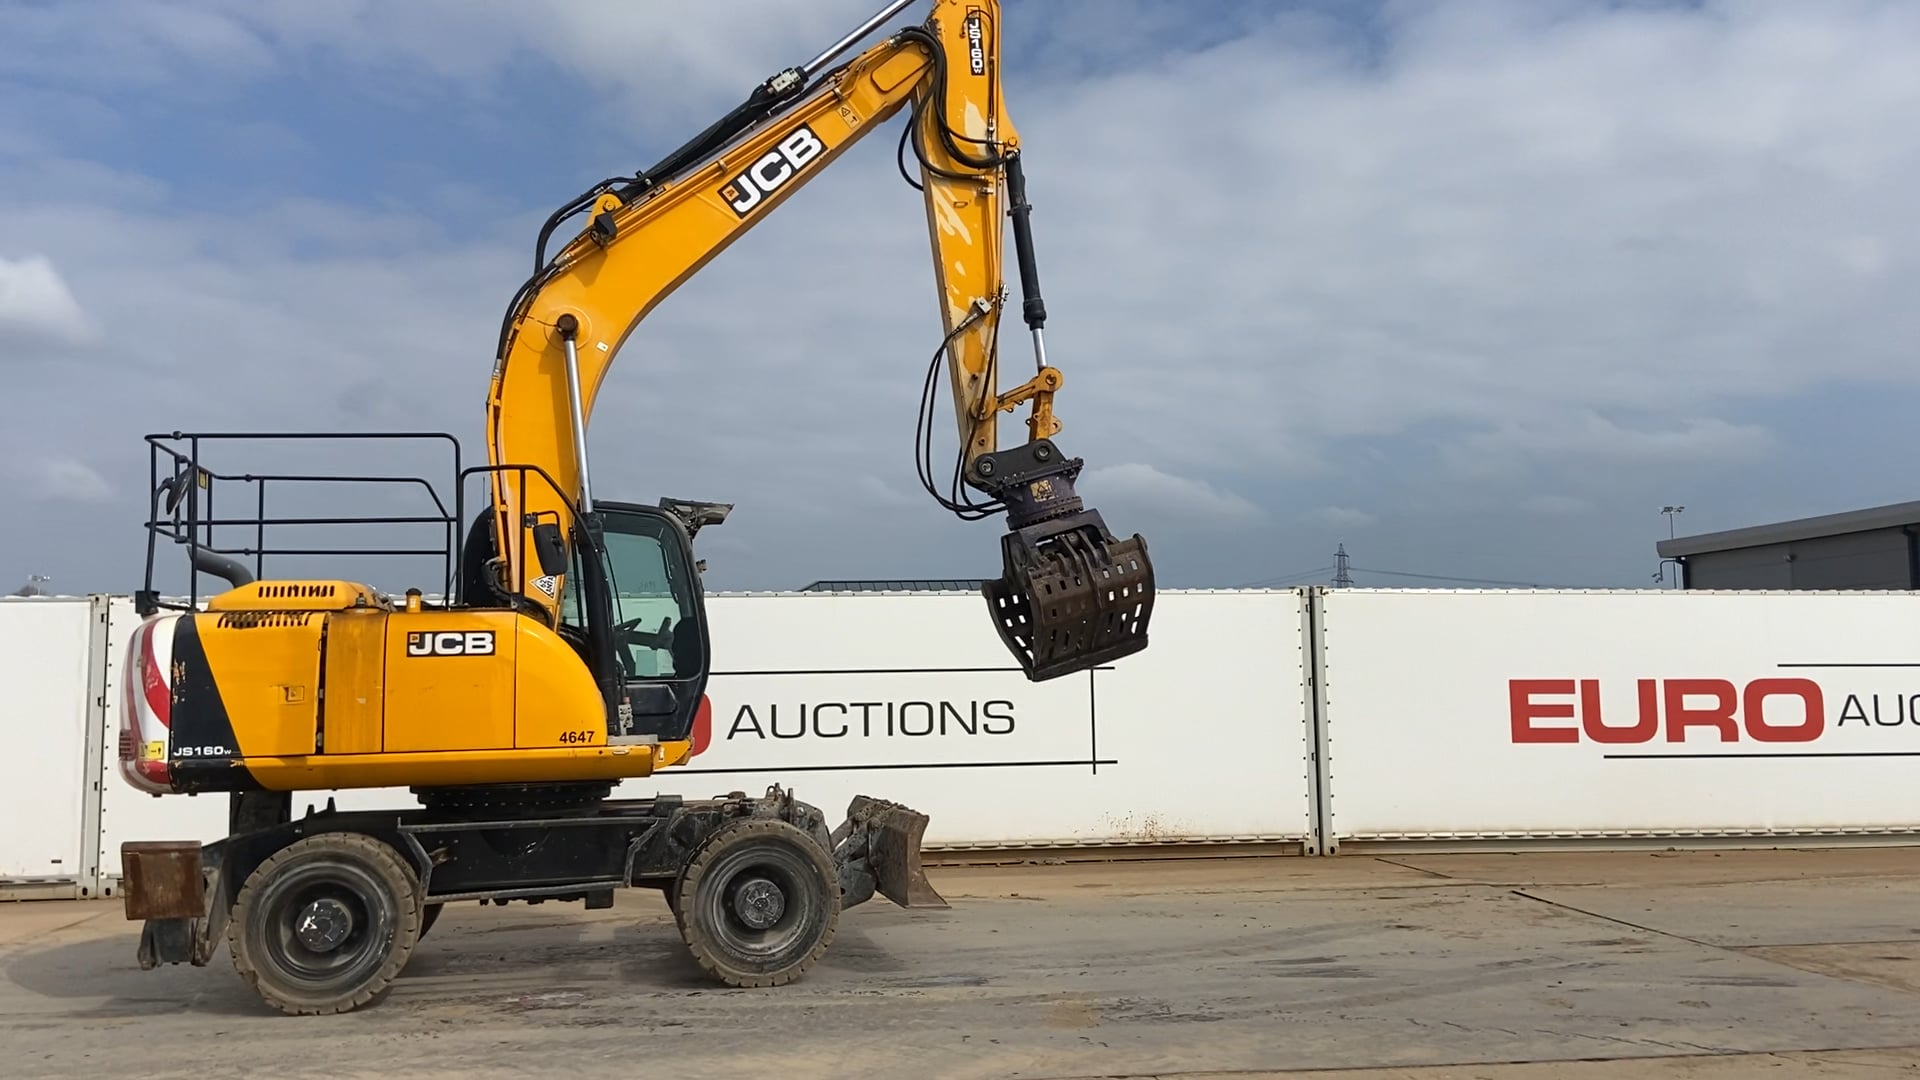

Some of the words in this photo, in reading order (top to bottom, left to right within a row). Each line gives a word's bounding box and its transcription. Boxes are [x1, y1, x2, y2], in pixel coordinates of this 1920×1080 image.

[733, 128, 822, 213] JCB
[409, 632, 494, 656] JCB
[726, 699, 1016, 740] AUCTIONS
[1508, 678, 1825, 744] EURO
[559, 730, 595, 743] 4647
